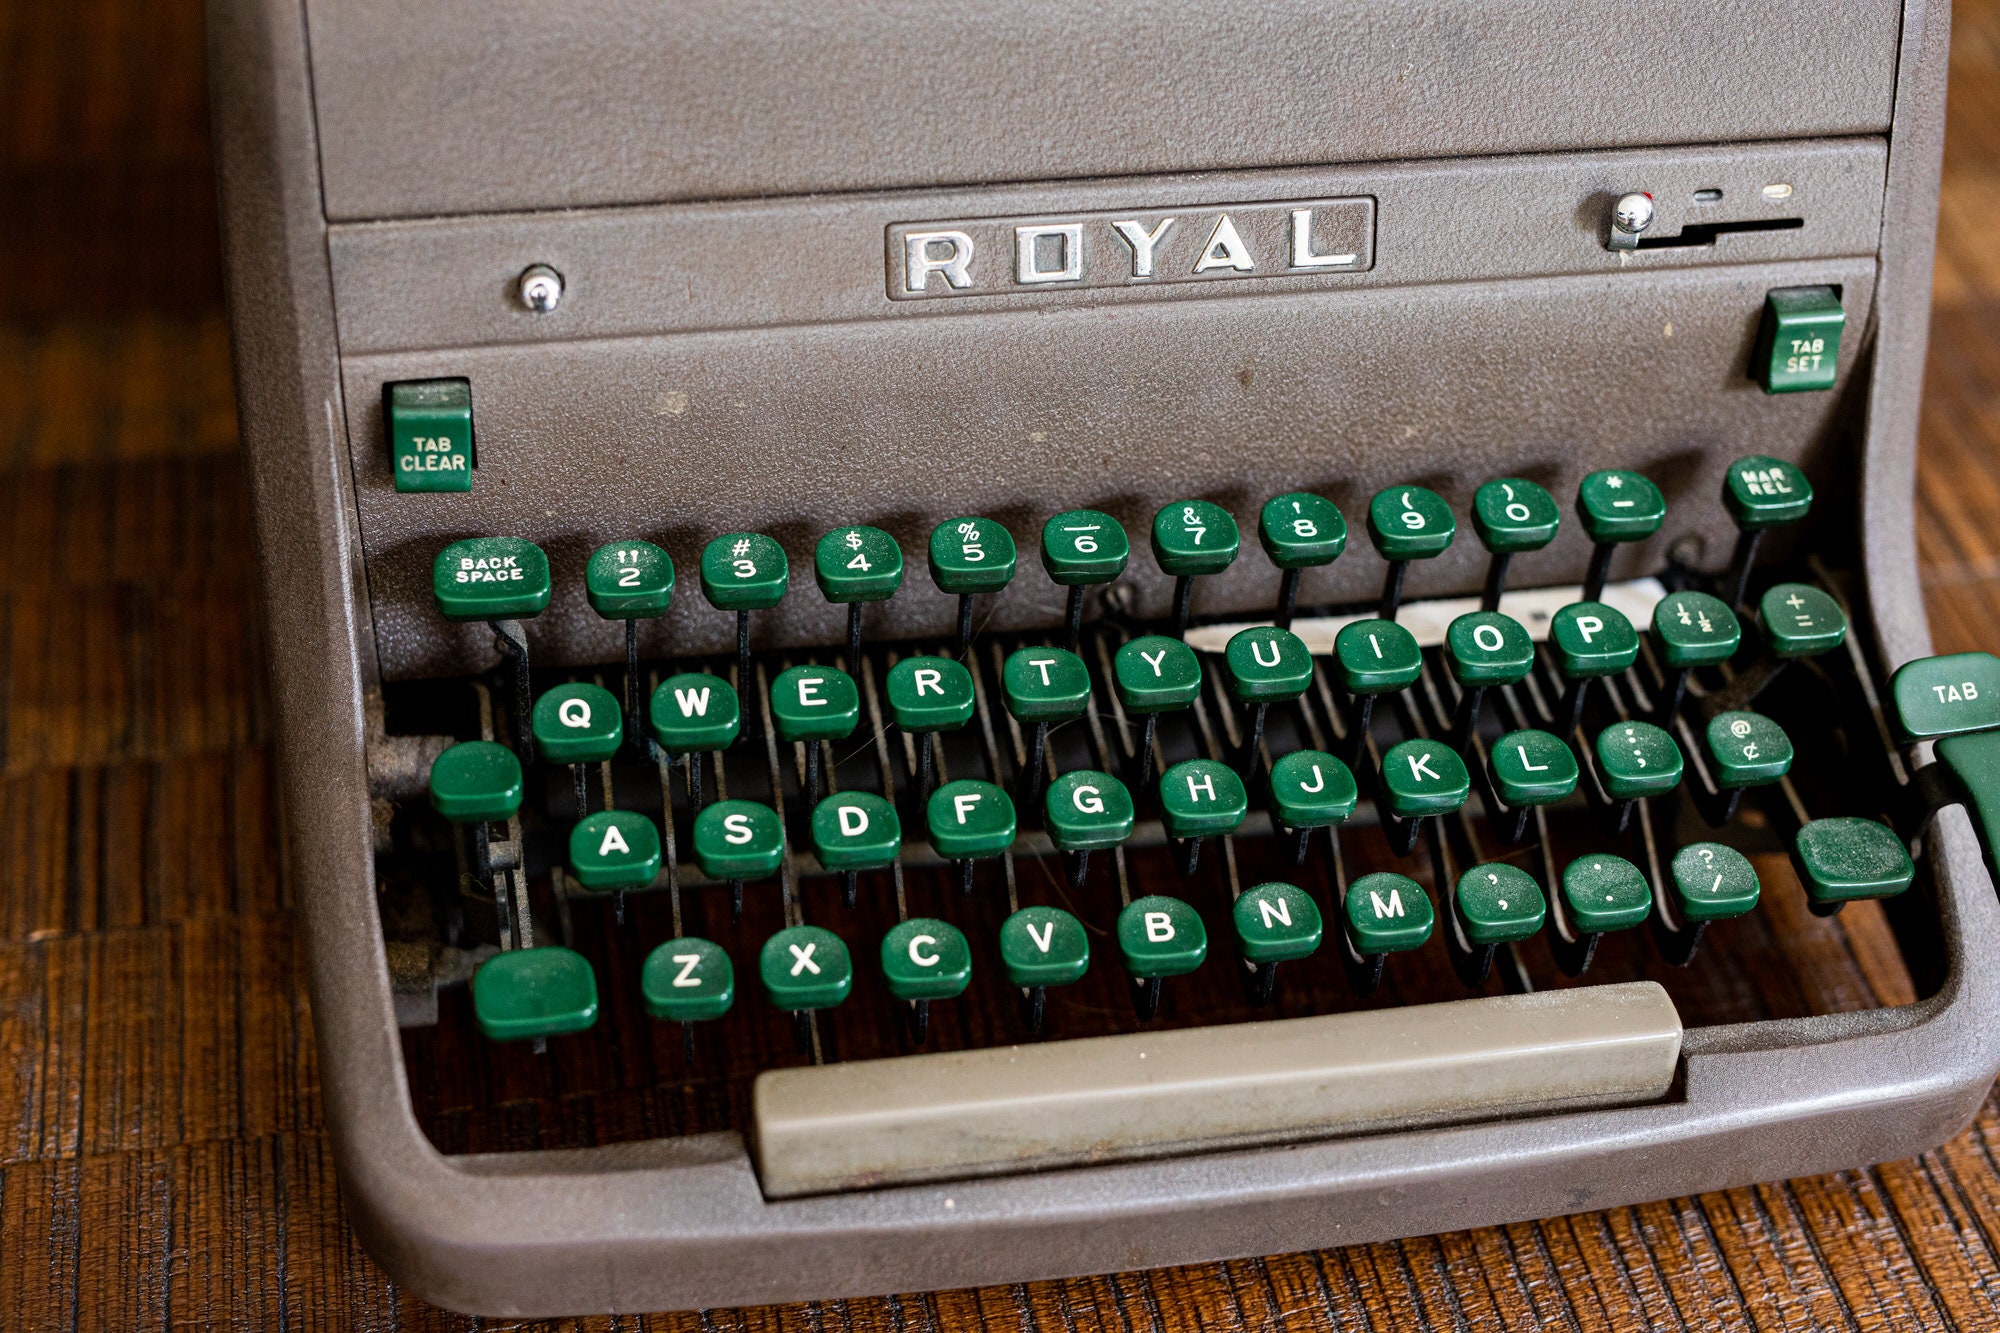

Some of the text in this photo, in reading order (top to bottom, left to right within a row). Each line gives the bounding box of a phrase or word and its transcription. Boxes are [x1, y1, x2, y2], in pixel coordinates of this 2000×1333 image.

[904, 209, 1356, 291] ROYAL
[1791, 338, 1825, 353] TAB
[1786, 355, 1822, 373] SET
[413, 436, 452, 452] TAB
[400, 454, 466, 472] CLEAR
[1741, 467, 1785, 483] MAR
[1747, 482, 1793, 496] REL
[1182, 506, 1203, 525] &
[1291, 519, 1318, 537] 8
[1401, 511, 1426, 530] 9
[845, 530, 863, 551] $
[957, 521, 981, 543] %
[1074, 535, 1099, 553] 6
[1184, 525, 1207, 545] 7
[731, 538, 751, 557] #
[963, 543, 986, 562] 5
[455, 568, 524, 583] SPACE
[460, 555, 517, 570] BACK
[732, 559, 757, 579] 3
[846, 553, 872, 572] 4
[618, 566, 641, 587] 2
[1473, 624, 1504, 652] O
[1576, 615, 1604, 643] P
[1250, 639, 1281, 668] U
[1368, 633, 1383, 659] I
[1028, 659, 1056, 687] T
[1140, 649, 1166, 677] Y
[797, 677, 828, 707] E
[914, 668, 945, 697] R
[1931, 681, 1979, 704] TAB
[558, 698, 592, 729] Q
[674, 686, 711, 718] W
[1730, 719, 1752, 739] @
[1407, 753, 1441, 782] K
[1517, 745, 1549, 772] L
[1187, 774, 1217, 803] H
[1300, 764, 1325, 793] J
[953, 793, 982, 825] F
[1072, 784, 1105, 814] G
[723, 813, 753, 845] S
[837, 805, 869, 837] D
[598, 825, 630, 857] A
[1698, 849, 1714, 870] ?
[1258, 897, 1293, 929] N
[1369, 888, 1405, 919] M
[1025, 921, 1054, 953] V
[1144, 911, 1176, 943] B
[788, 942, 821, 977] X
[908, 934, 940, 967] C
[672, 953, 702, 988] Z
